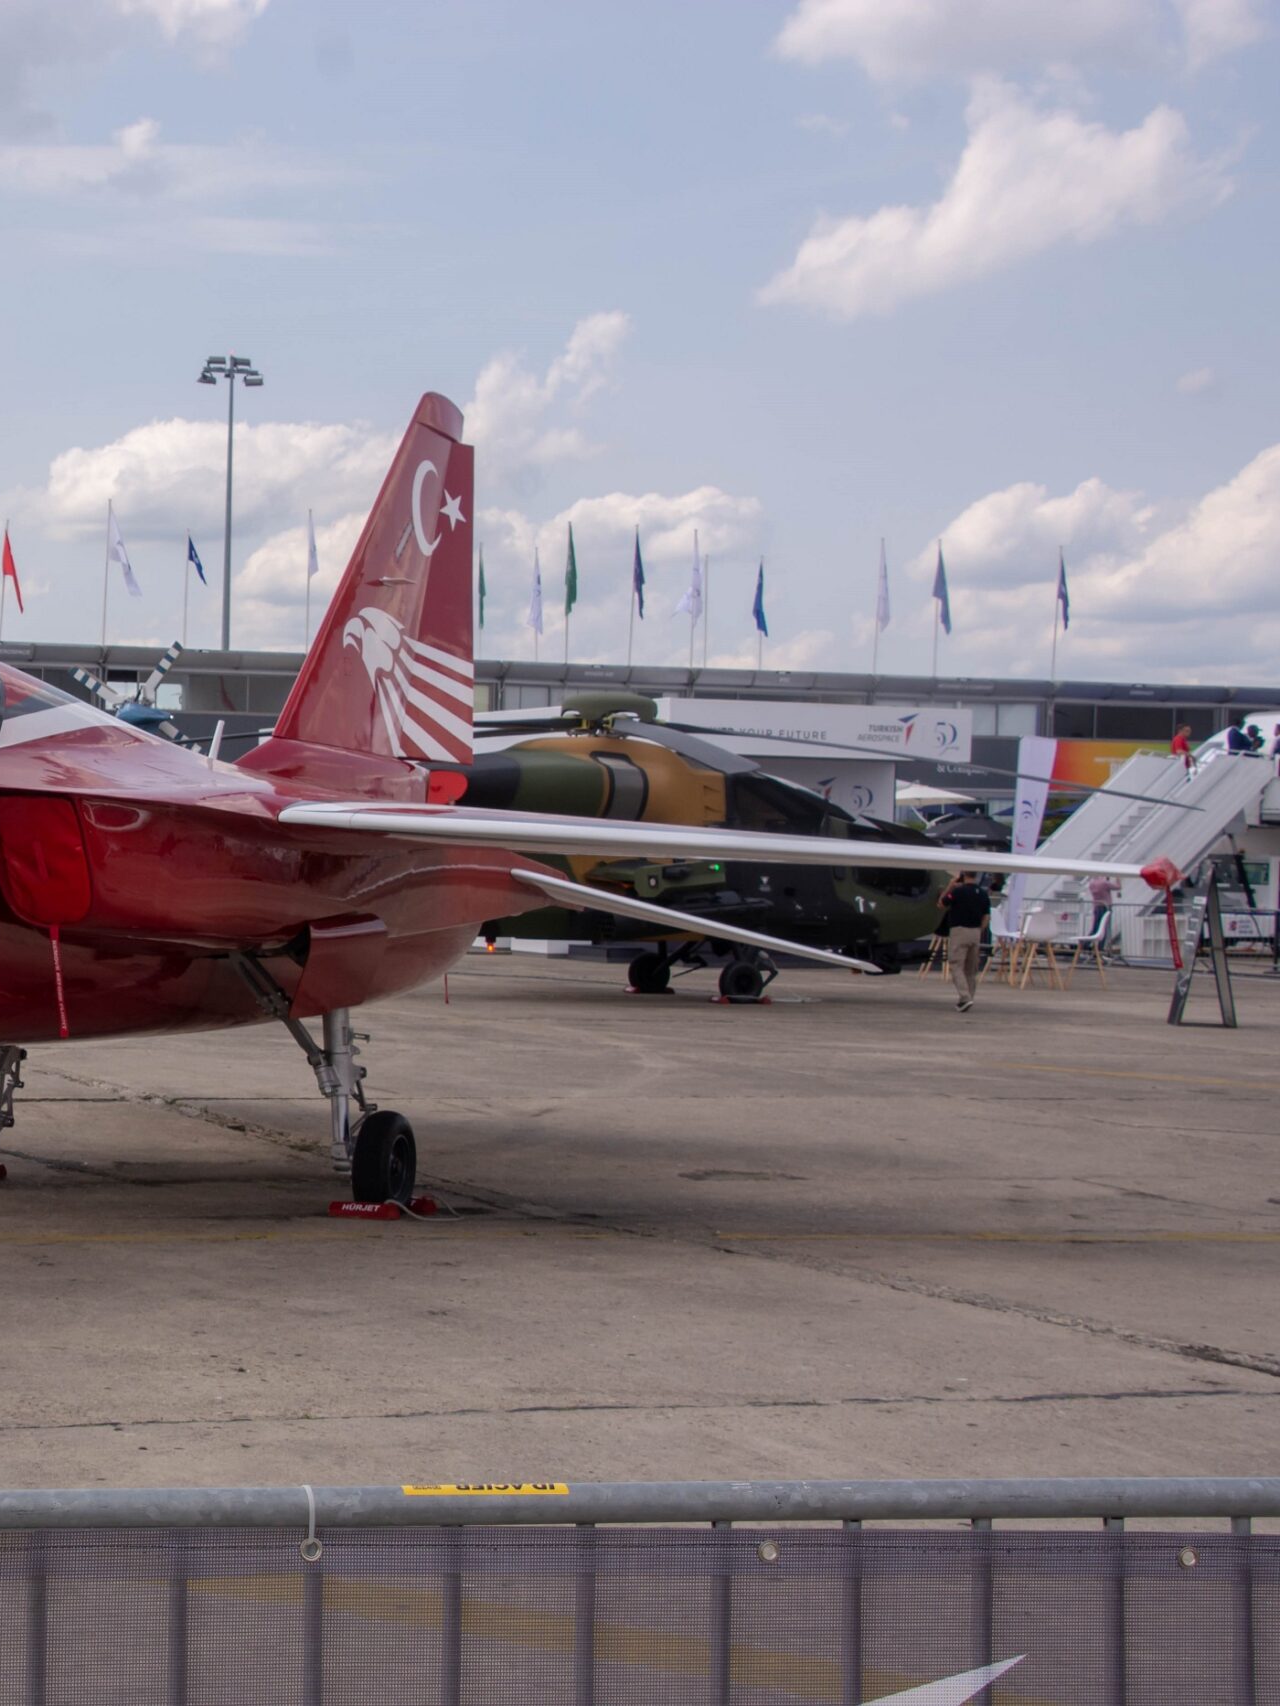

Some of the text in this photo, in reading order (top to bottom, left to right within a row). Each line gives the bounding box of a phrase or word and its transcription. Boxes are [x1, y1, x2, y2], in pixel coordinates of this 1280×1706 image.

[868, 724, 903, 734] TURKISH
[778, 730, 828, 741] FUTURE
[856, 733, 901, 743] AEROSPACE
